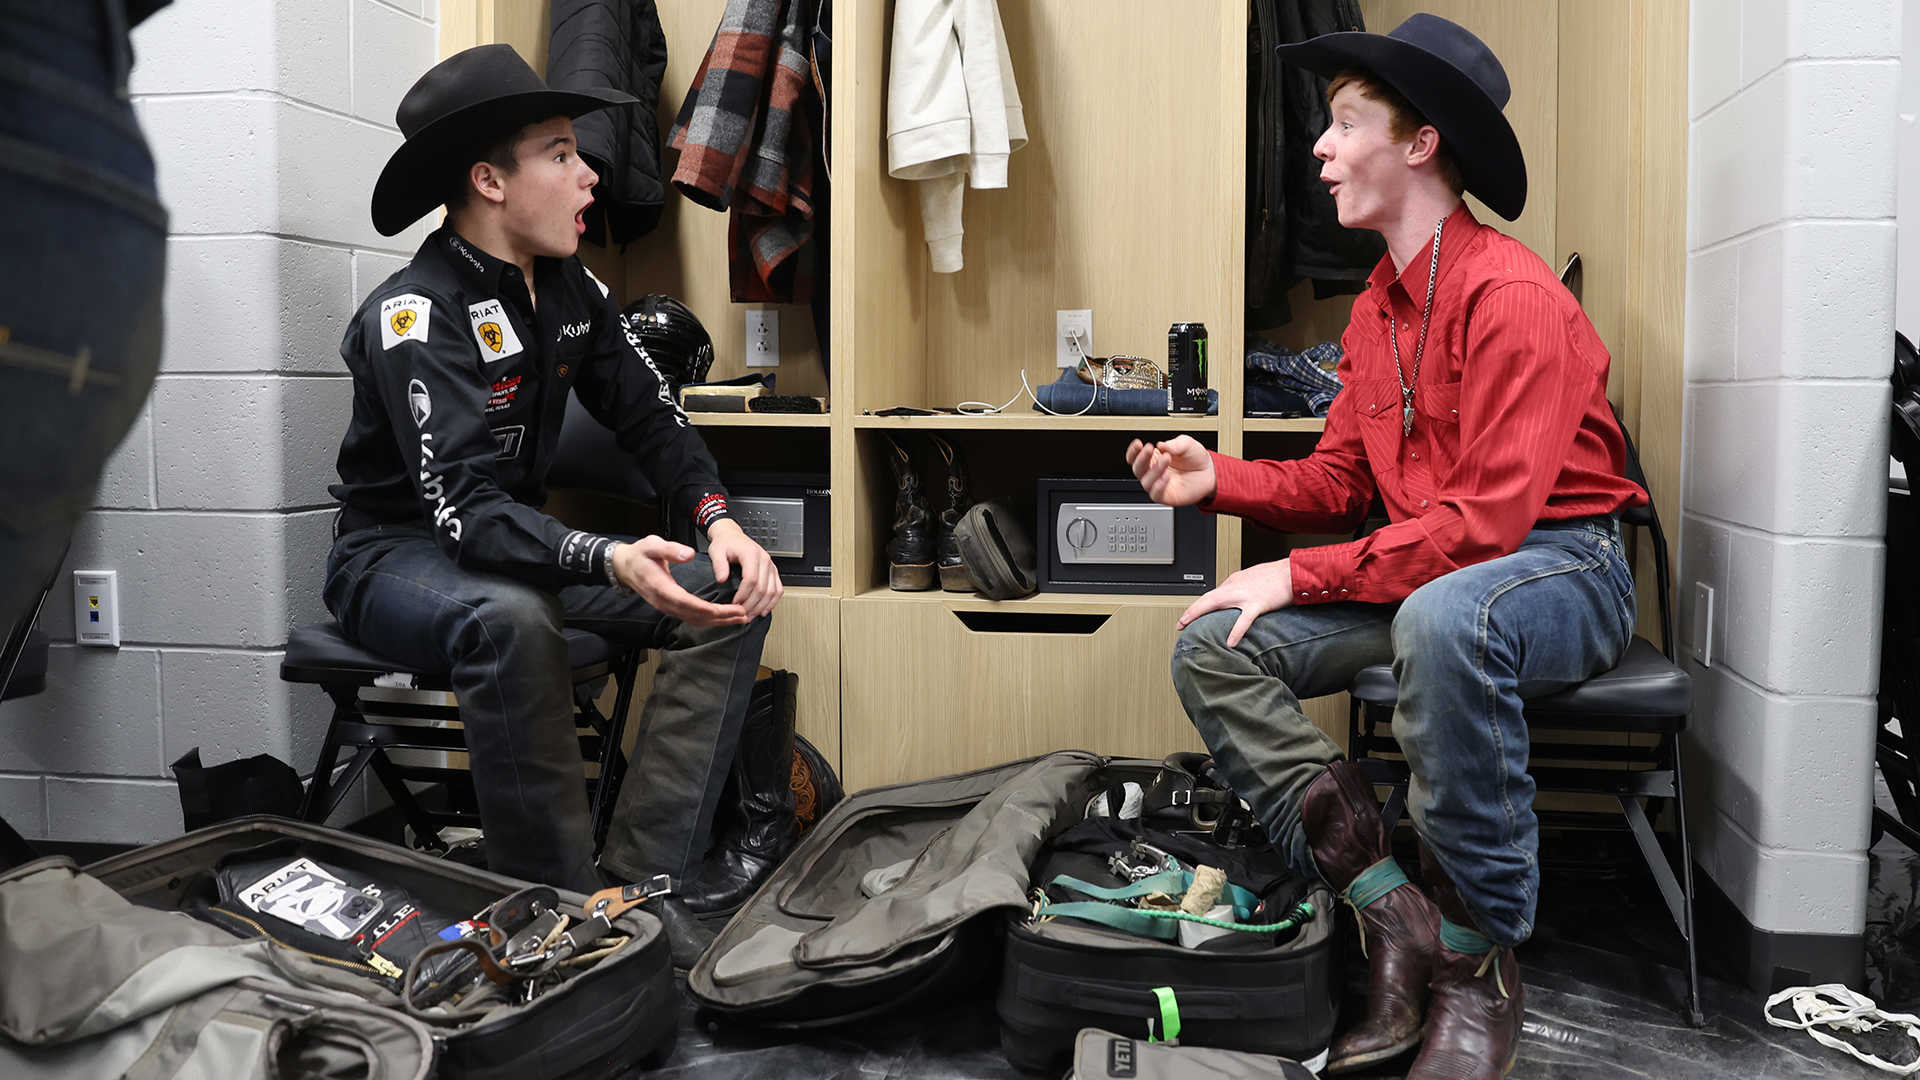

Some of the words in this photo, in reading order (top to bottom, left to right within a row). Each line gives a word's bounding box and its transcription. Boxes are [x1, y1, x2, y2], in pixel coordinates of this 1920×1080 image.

[383, 299, 429, 312] ARIAT
[470, 304, 500, 320] RIAT
[250, 861, 308, 904] ARIAT
[1115, 1041, 1131, 1071] YETI
